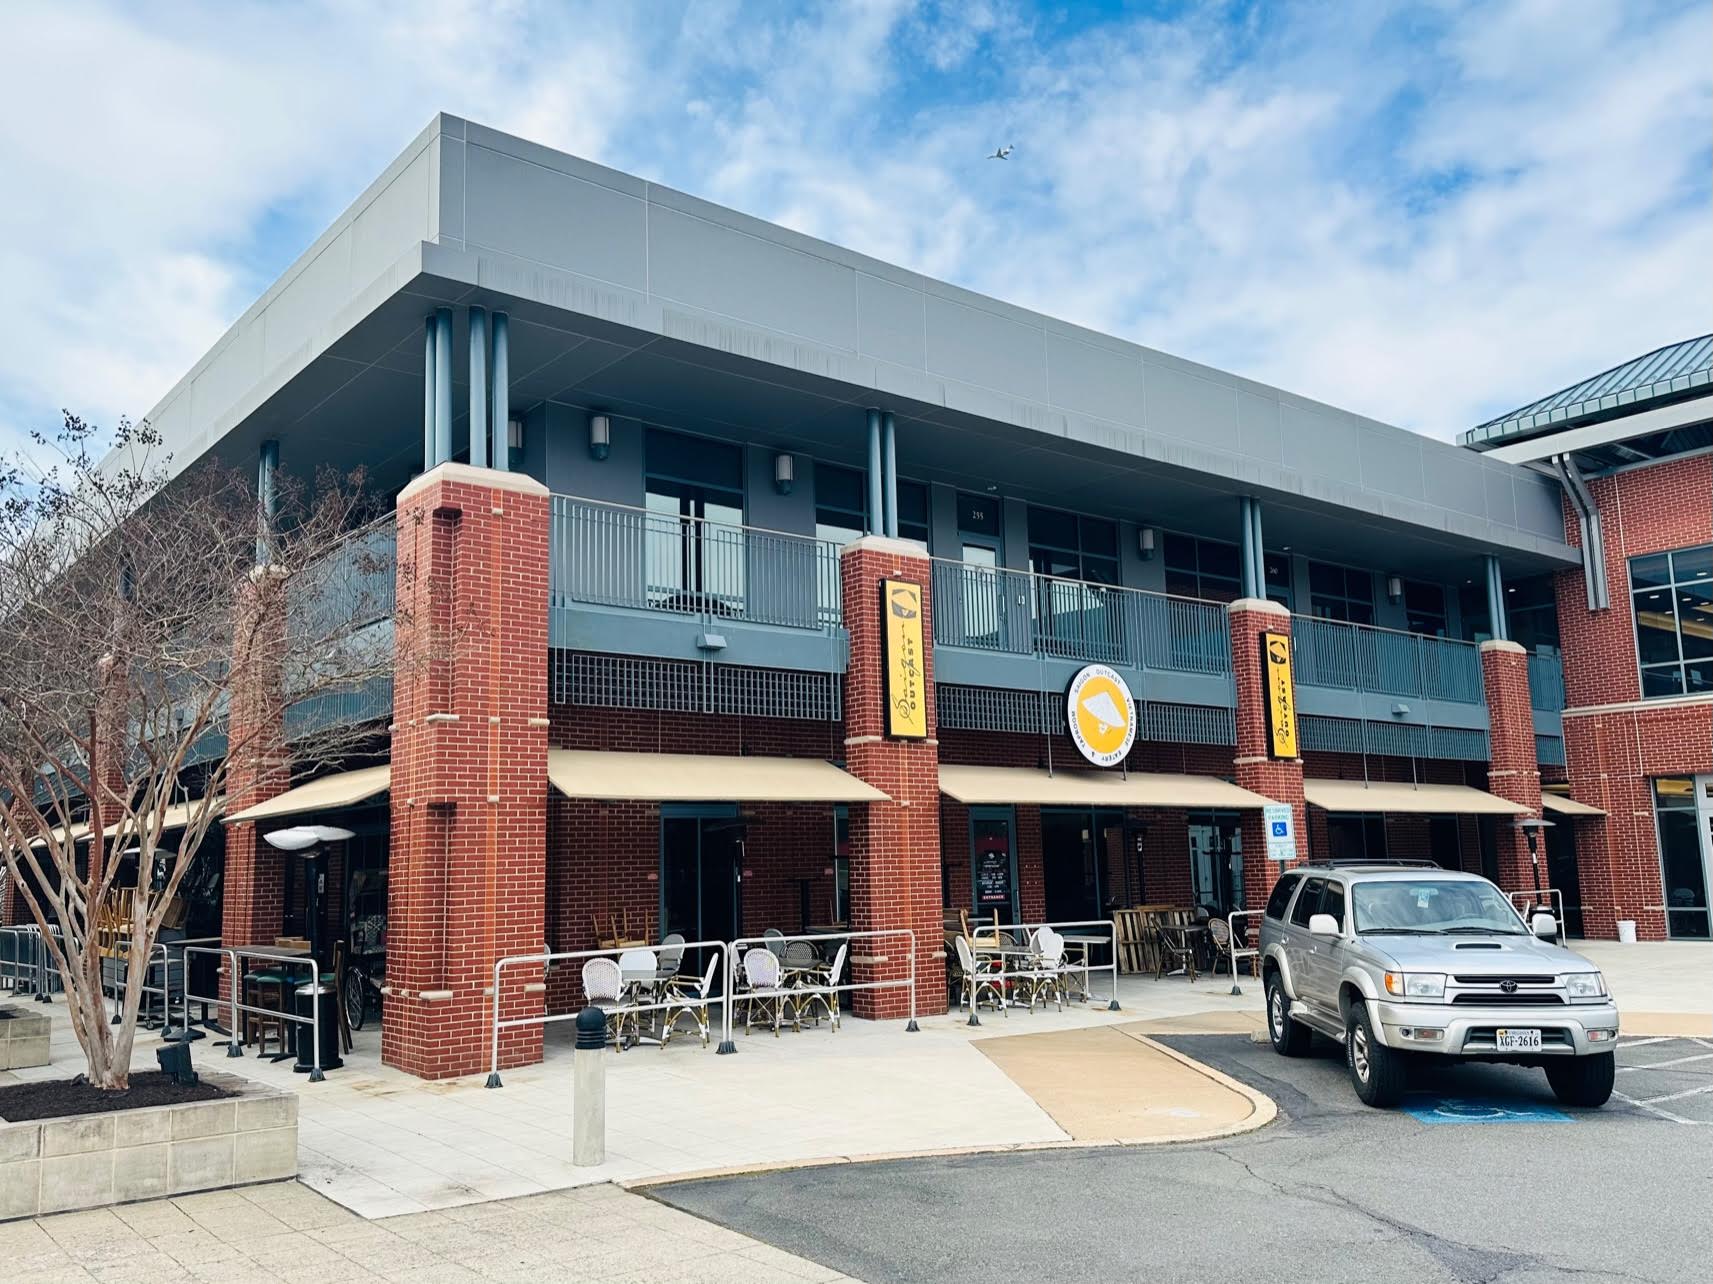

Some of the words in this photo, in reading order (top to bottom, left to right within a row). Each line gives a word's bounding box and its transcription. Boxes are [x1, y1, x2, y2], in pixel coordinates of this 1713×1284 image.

[891, 621, 920, 724] Saigon
[907, 638, 916, 710] OUTCAST
[1074, 672, 1091, 693] SAIGON
[1095, 669, 1121, 685] OUTCAST
[1071, 711, 1086, 748] TAPROOM
[1281, 680, 1290, 737] OUTCAST
